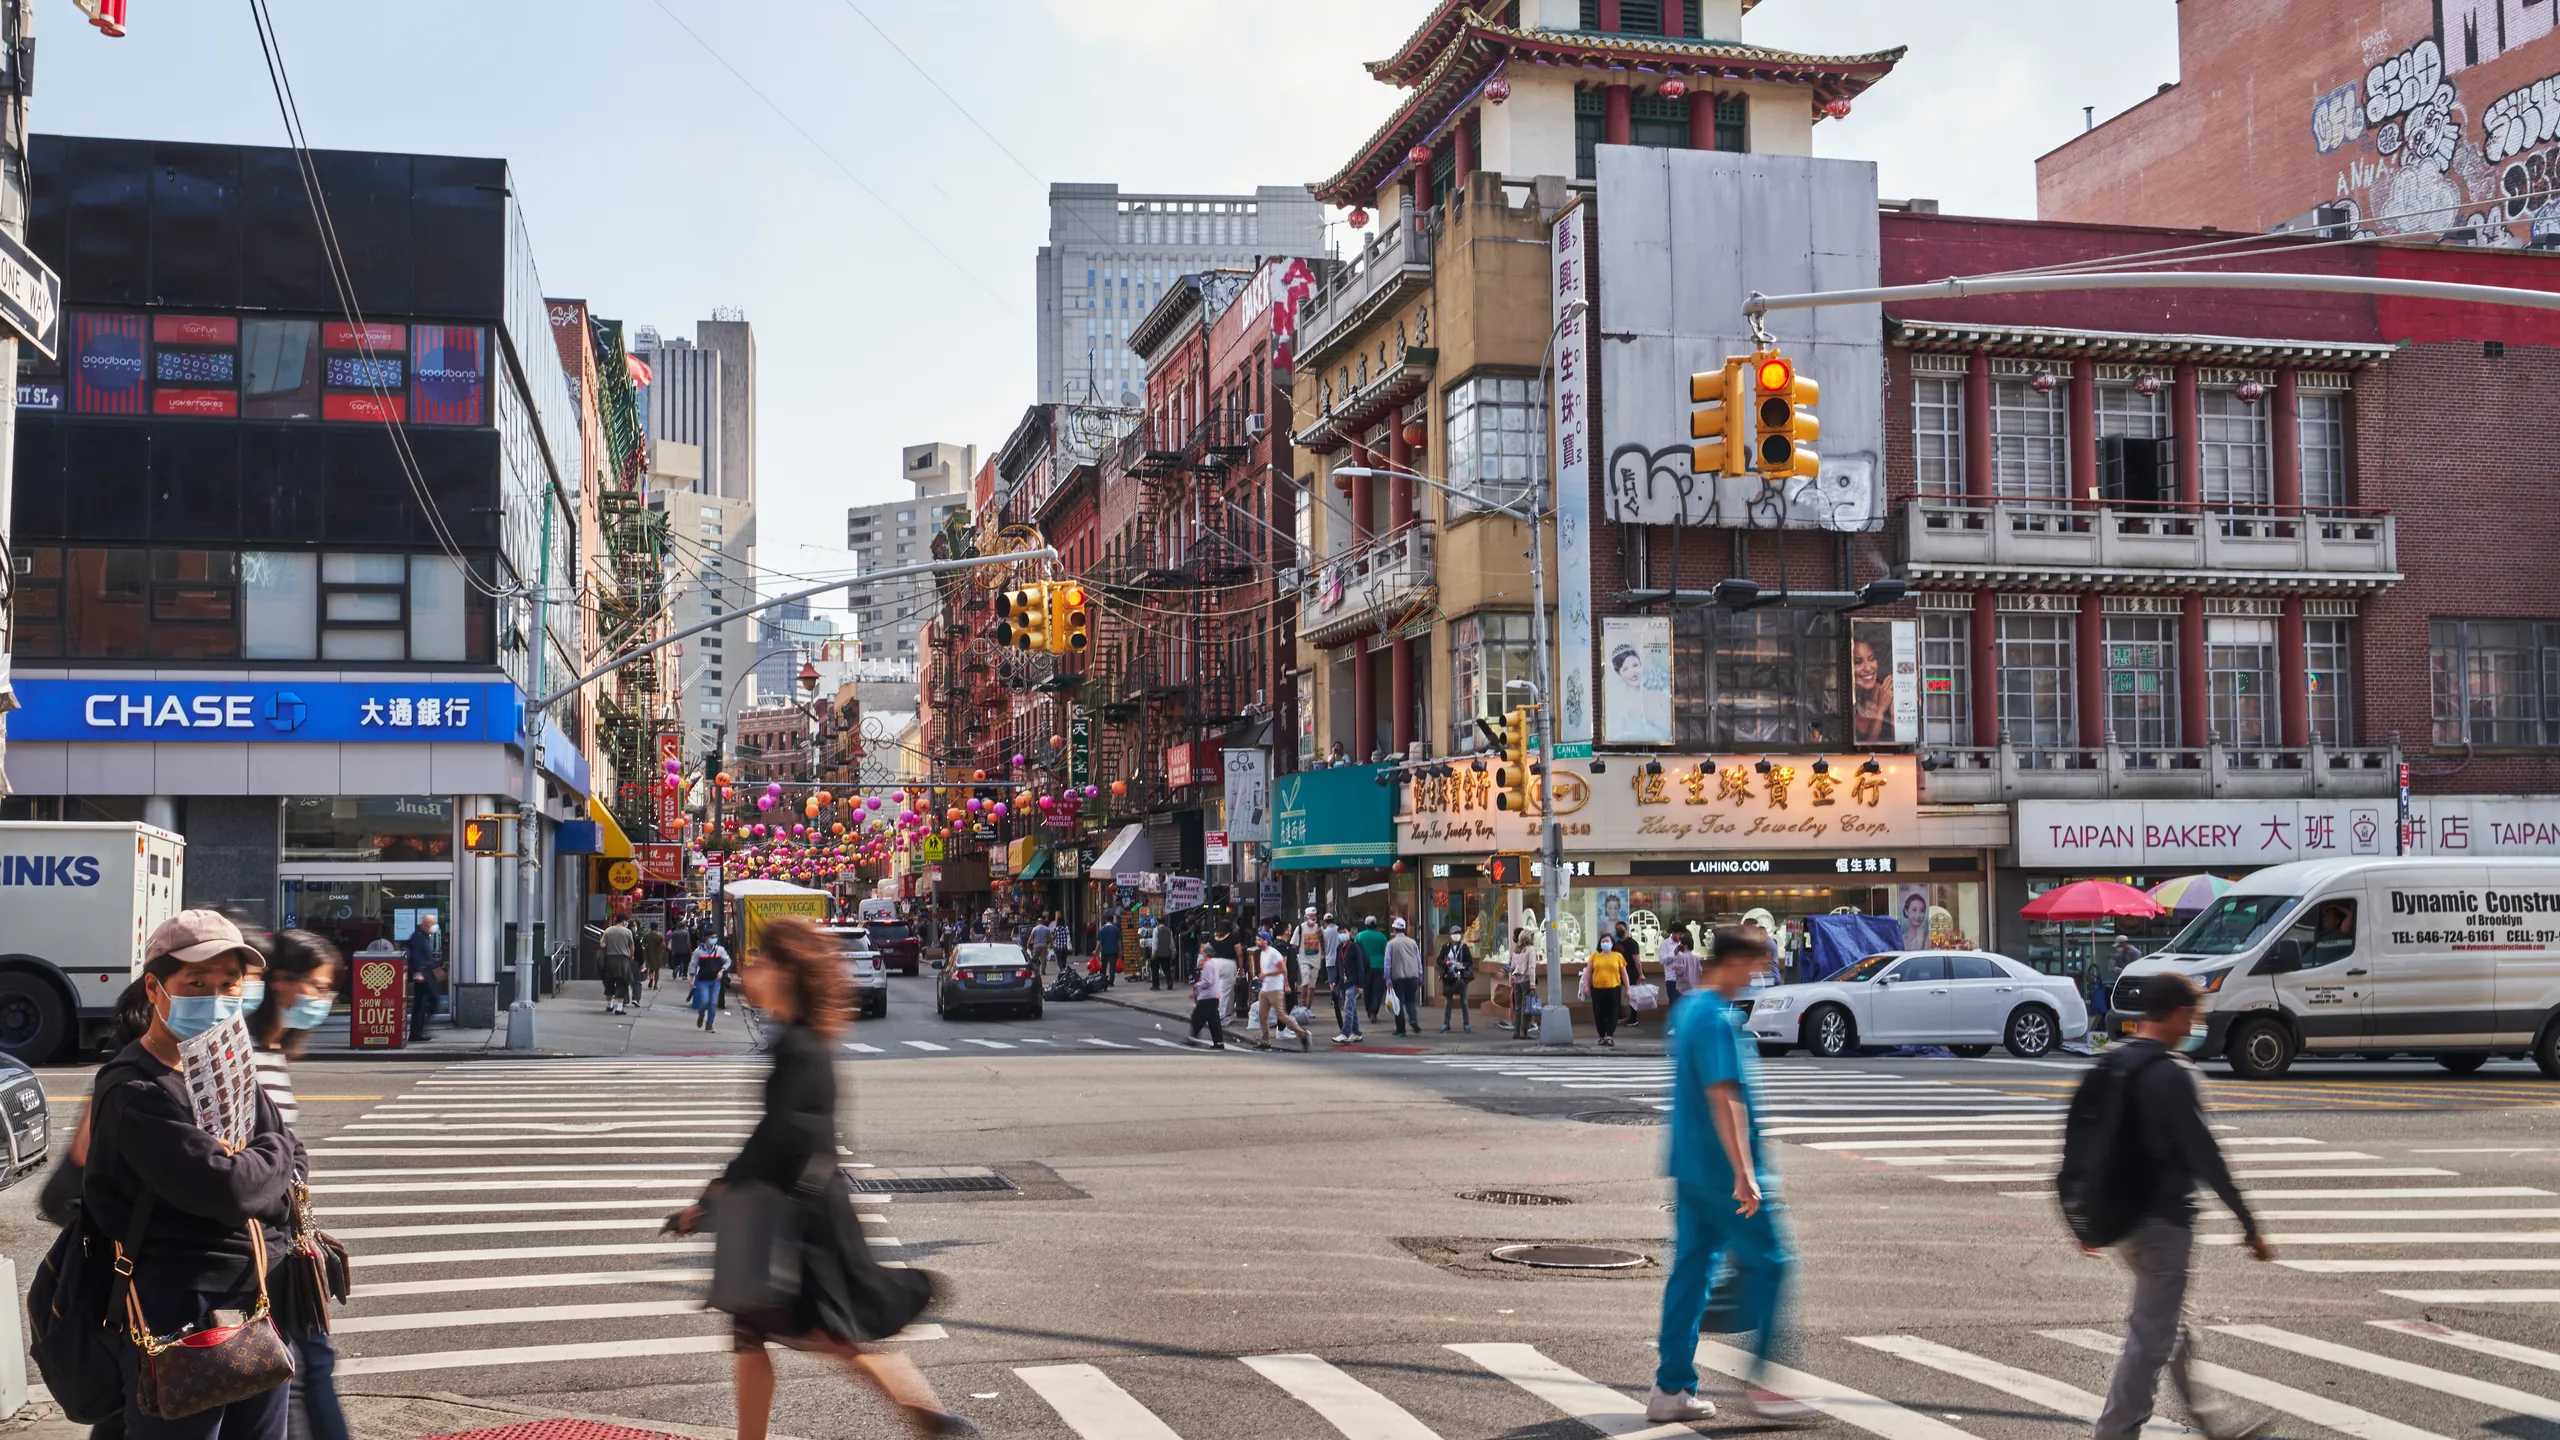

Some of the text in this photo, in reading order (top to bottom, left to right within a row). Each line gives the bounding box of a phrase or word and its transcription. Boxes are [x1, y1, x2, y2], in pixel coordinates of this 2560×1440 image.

[1, 260, 49, 323] ONE WAY
[1572, 209, 1582, 464] LAIHNG.COM
[33, 388, 49, 403] ST.
[85, 694, 255, 727] CHASE
[360, 698, 470, 727] 大通銀行
[1556, 746, 1580, 754] CANAL
[1411, 823, 1429, 845] Hung
[1443, 819, 1472, 842] Jewelry
[1475, 820, 1495, 840] Corp.
[1637, 814, 1890, 839] Hung Too Jewelry Corp.
[2049, 824, 2242, 848] TAIPAN BAKERY
[2260, 814, 2336, 850] 大班
[0, 855, 100, 887] INKS
[1690, 860, 1769, 873] LAIHING.COM
[756, 902, 816, 911] HAPPY VEGGIE
[2391, 890, 2479, 915] Dynamic
[863, 909, 892, 920] FedEx
[2466, 915, 2523, 927] of Brooklyn
[2392, 932, 2415, 944] TEL:
[2416, 930, 2495, 944] 646-724-6161
[2506, 930, 2534, 943] CELL:
[359, 998, 381, 1007] SHOW
[359, 1008, 395, 1025] LOVE
[371, 1025, 395, 1034] CLEAN
